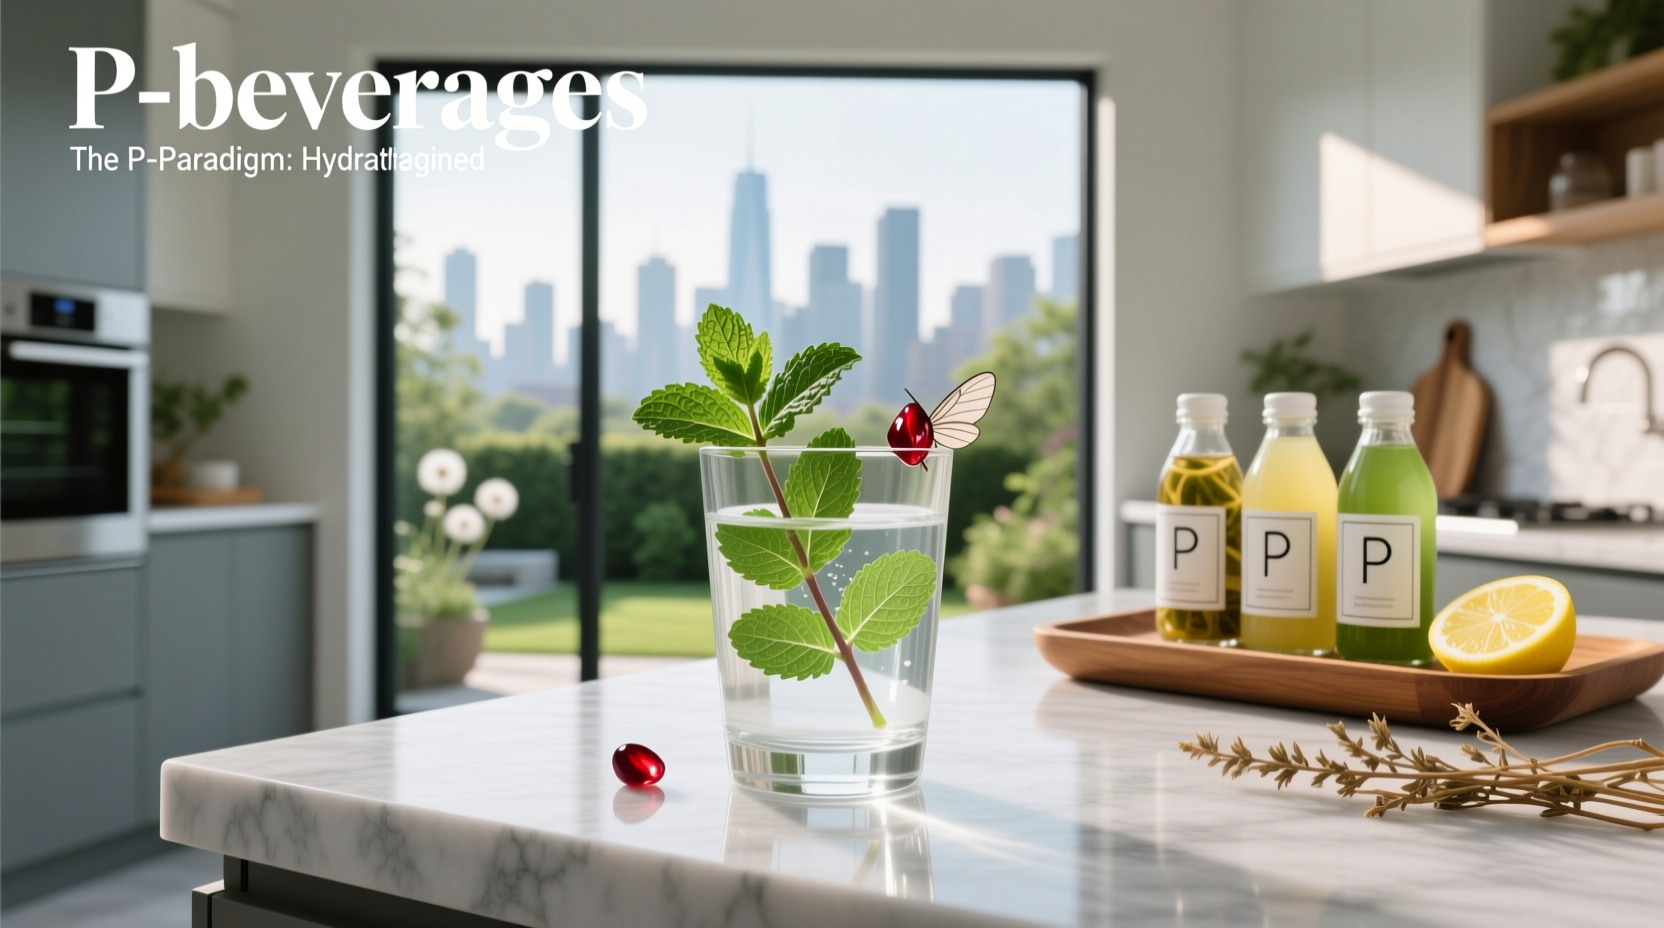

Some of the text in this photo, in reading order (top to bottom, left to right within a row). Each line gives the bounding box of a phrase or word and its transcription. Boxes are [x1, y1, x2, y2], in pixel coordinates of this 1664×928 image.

[1174, 526, 1199, 570] P
[1264, 531, 1291, 577] P
[1362, 536, 1392, 584] P
